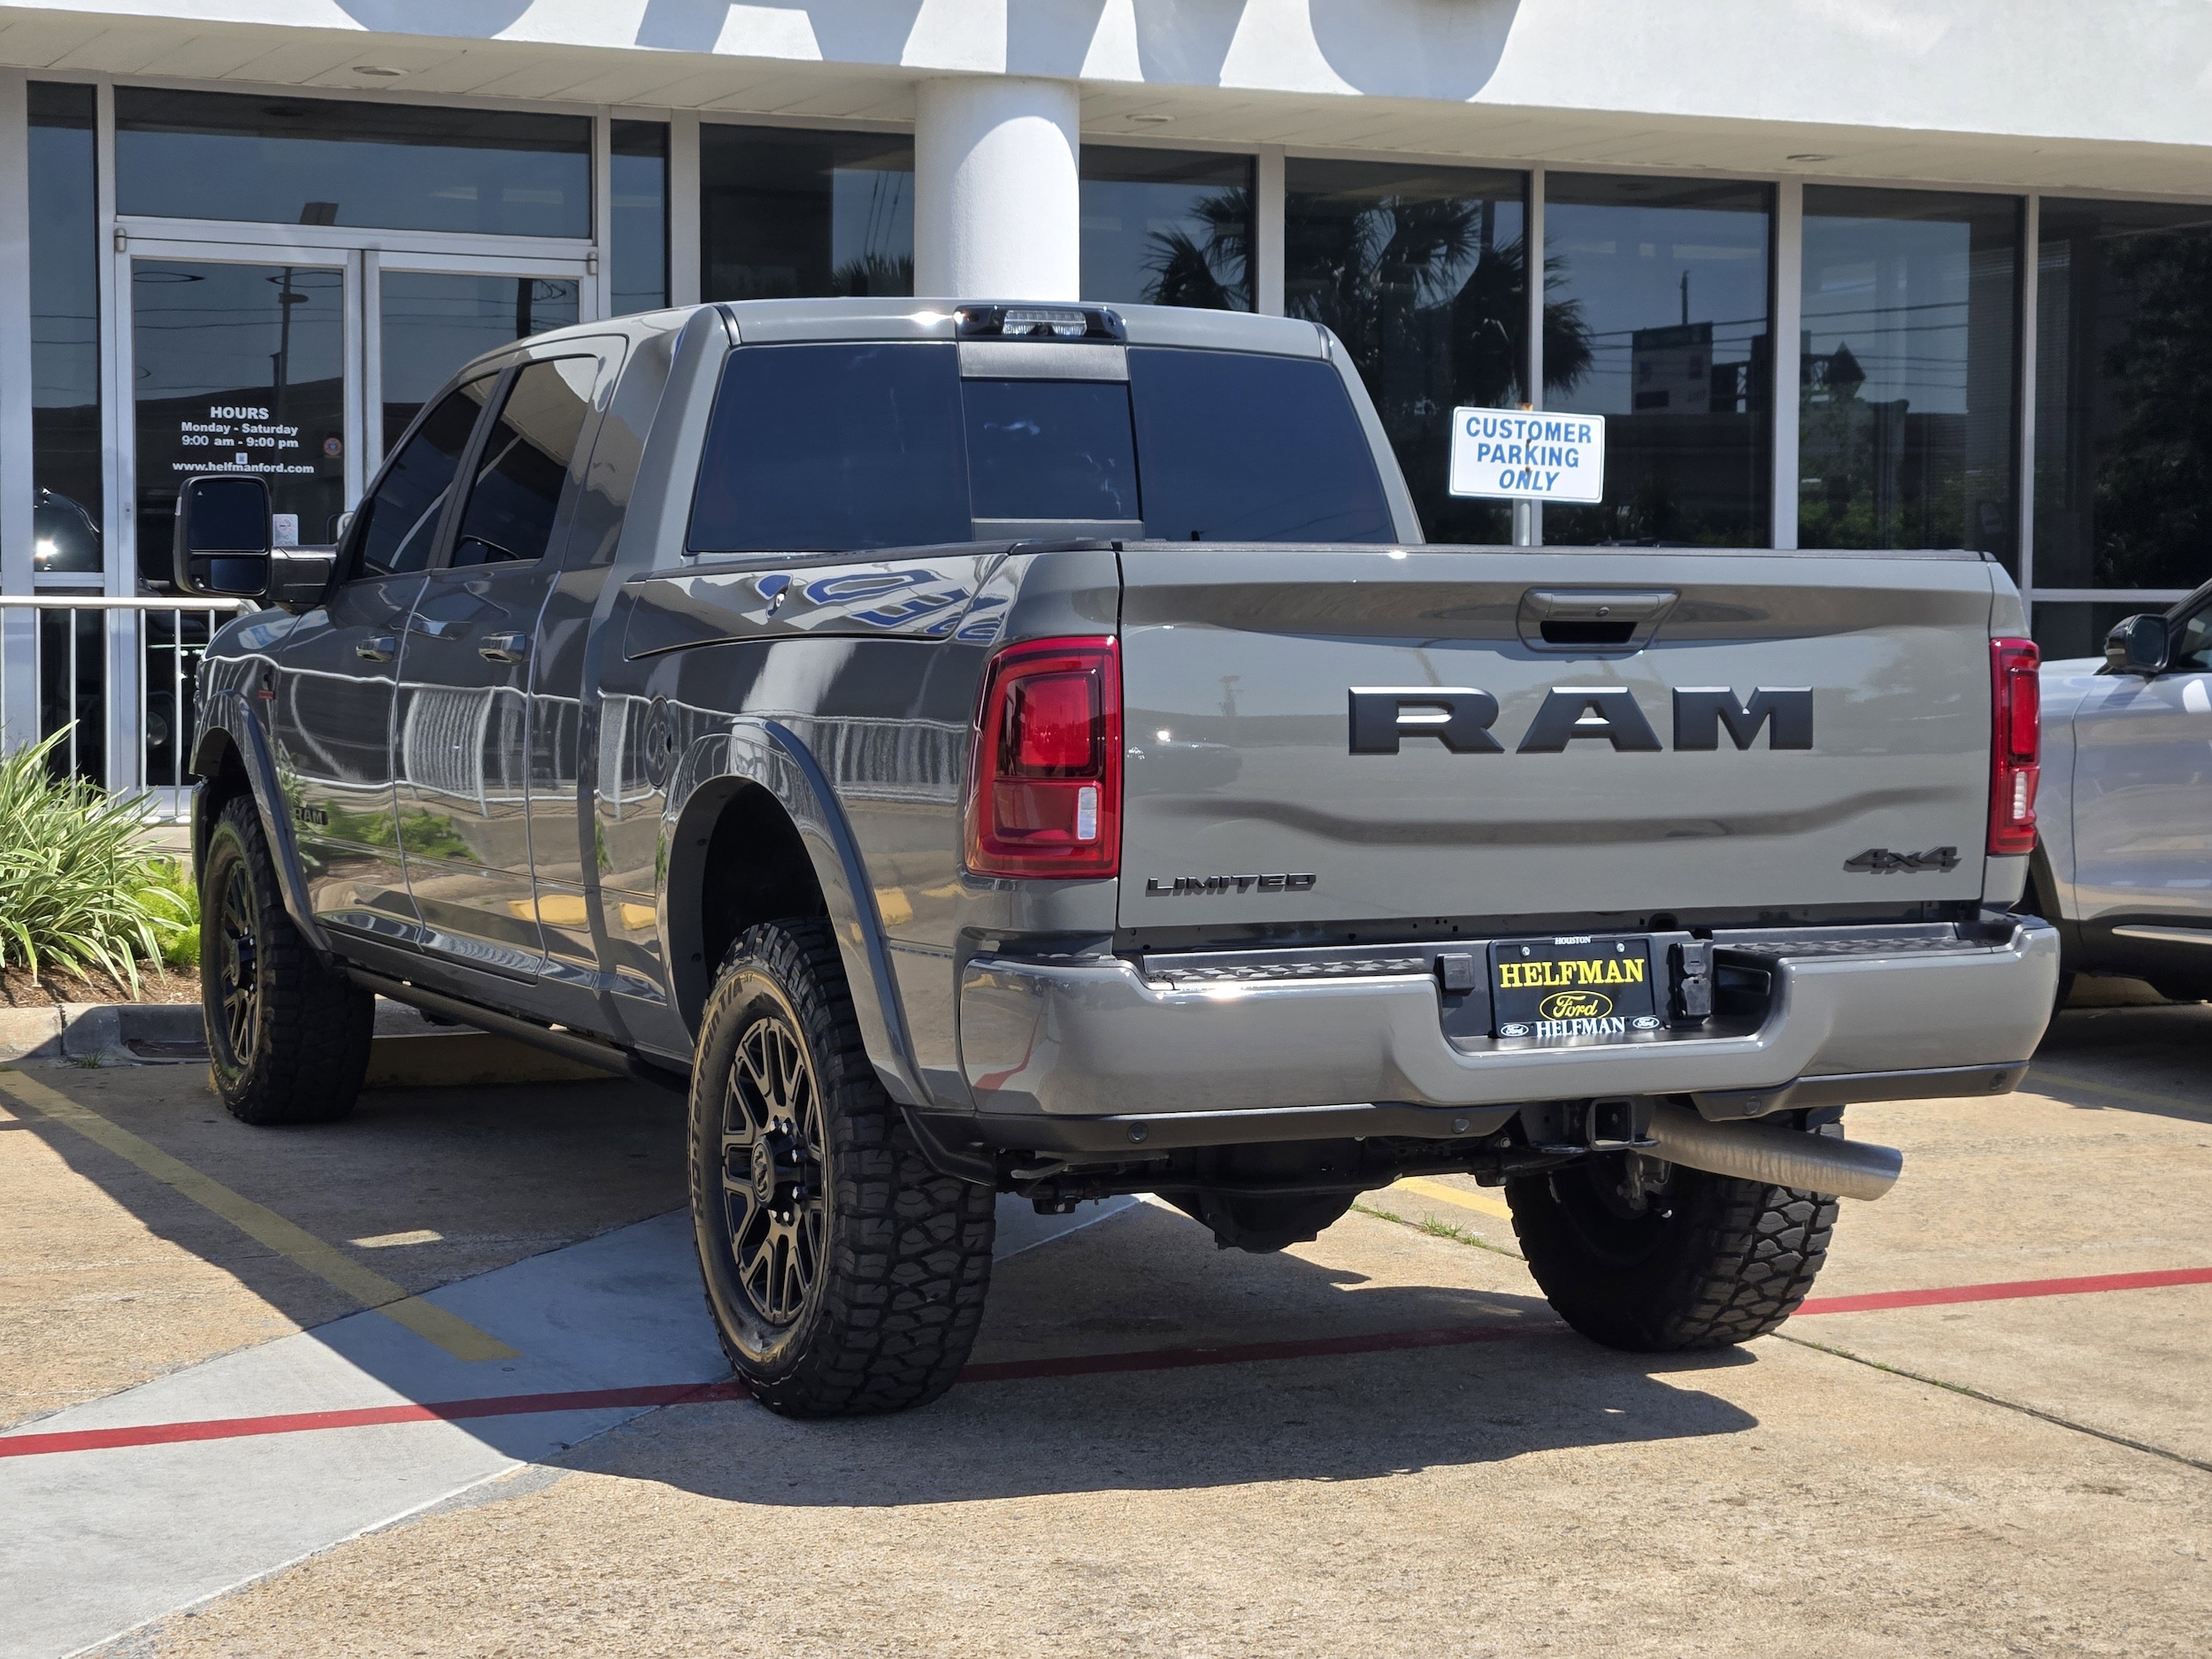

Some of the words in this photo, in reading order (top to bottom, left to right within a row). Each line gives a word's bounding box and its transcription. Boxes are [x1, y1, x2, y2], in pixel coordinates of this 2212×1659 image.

[210, 406, 270, 420] HOURS
[180, 421, 231, 434] Monday
[242, 423, 299, 436] Saturday
[1466, 416, 1592, 444] CUSTOMER
[181, 434, 210, 446] 9:00
[214, 437, 235, 447] am
[246, 437, 275, 448] 9:00
[278, 440, 299, 449] pm
[1477, 442, 1579, 468] PARKING
[172, 461, 315, 473] www.helfmanford.com
[1499, 469, 1561, 492] ONLY
[1348, 686, 1814, 756] RAM
[292, 806, 324, 825] RAM
[1146, 872, 1317, 895] LIMITED
[1554, 936, 1593, 945] HOUSTON
[1498, 958, 1646, 988] HELFMAN
[1552, 995, 1599, 1018] Ford
[1535, 1017, 1626, 1038] HELFMAN
